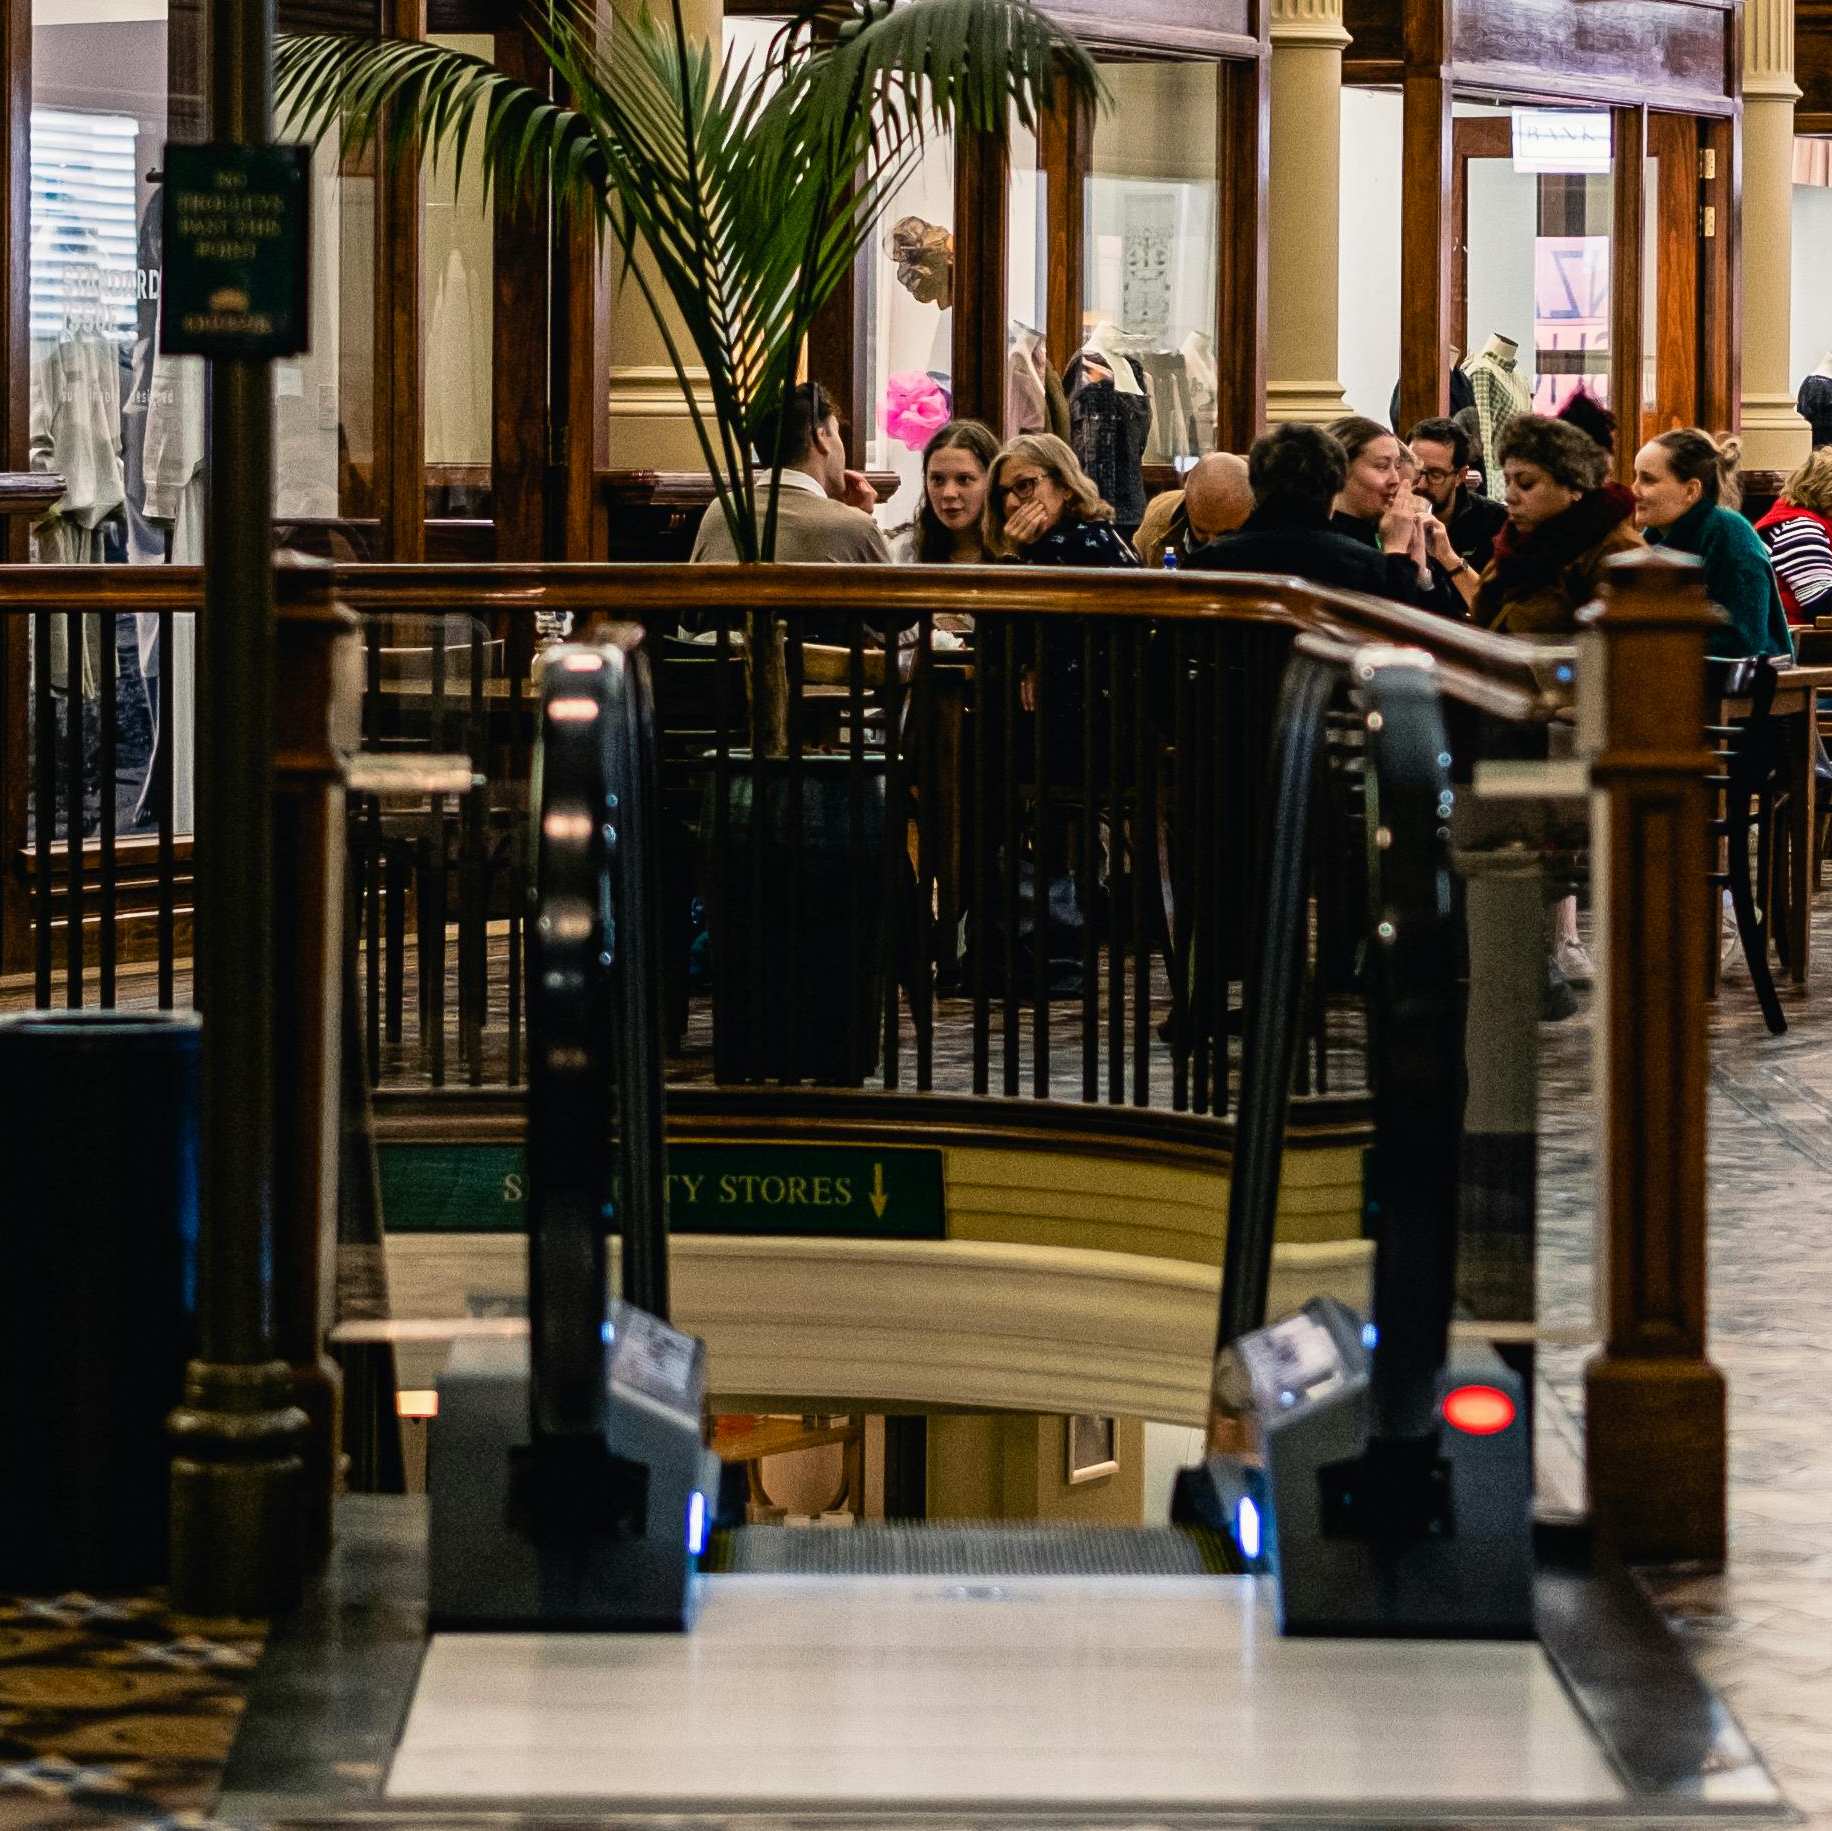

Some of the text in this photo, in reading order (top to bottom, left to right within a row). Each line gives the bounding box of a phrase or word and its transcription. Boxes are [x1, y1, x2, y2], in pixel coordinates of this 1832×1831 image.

[63, 266, 161, 300] STANDARD
[63, 304, 116, 332] ISSUE
[718, 1175, 852, 1206] STORES
